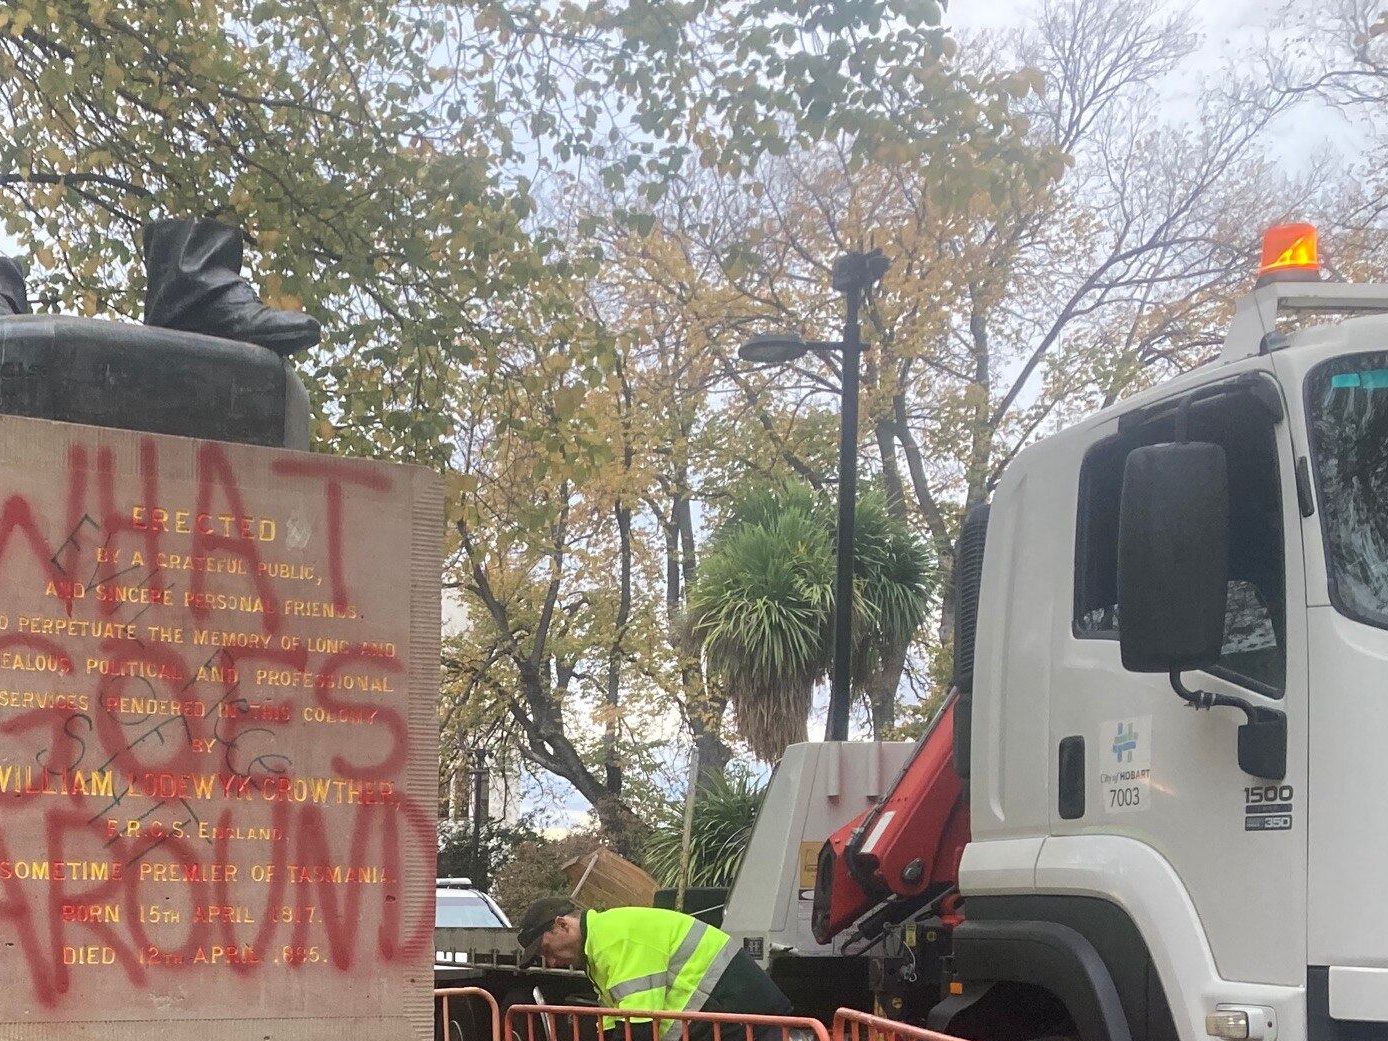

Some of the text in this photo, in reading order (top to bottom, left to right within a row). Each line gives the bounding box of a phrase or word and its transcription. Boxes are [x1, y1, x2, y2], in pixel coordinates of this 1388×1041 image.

[132, 504, 276, 542] ERECTED
[96, 546, 323, 586] BY A GRATEFUL PUBLIC,
[45, 581, 86, 599] AND
[184, 591, 276, 615] PERSONAL
[18, 616, 136, 641] PERPETUATE
[148, 625, 184, 644] THE
[193, 629, 272, 650] MEMORY
[280, 634, 301, 652] OF
[307, 637, 350, 656] LONG
[361, 641, 397, 658] AND
[86, 658, 183, 680] POLITICAL
[196, 665, 239, 684] AND
[256, 669, 395, 692] PROFESSIONAL
[106, 697, 206, 717] RENDERED
[217, 701, 237, 718] IN
[303, 706, 380, 725] COLONY
[192, 738, 217, 754] BY
[1119, 768, 1151, 781] HOBART
[127, 771, 252, 801] LODEWYK
[1244, 784, 1294, 804] 1500
[1109, 787, 1140, 809] 7003
[107, 818, 191, 839] F.R.C.S.
[1264, 816, 1291, 829] 350
[0, 860, 124, 882] SOMETIME
[139, 863, 238, 883] PREMIER
[251, 864, 276, 883] OF
[62, 904, 120, 924] BORN
[139, 904, 181, 924] 15TH
[193, 905, 256, 924] APRIL
[63, 946, 116, 966] DIED
[193, 945, 260, 965] APRIL
